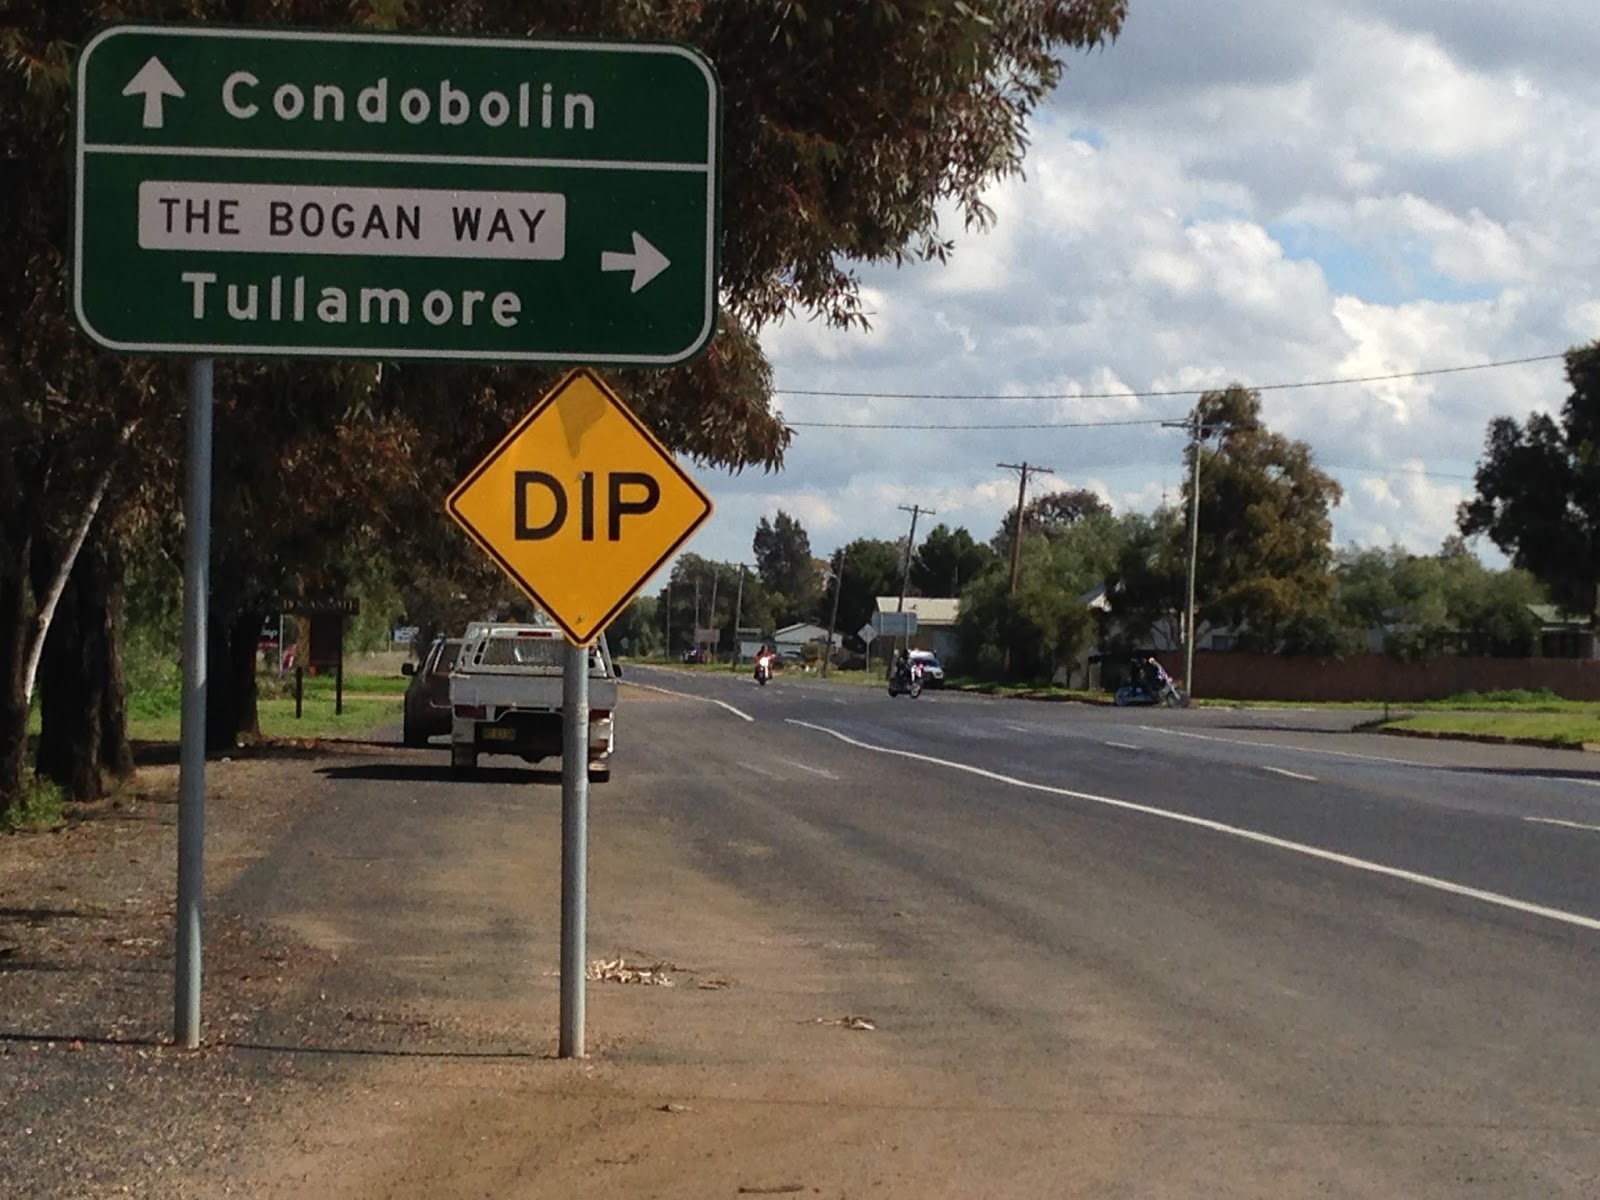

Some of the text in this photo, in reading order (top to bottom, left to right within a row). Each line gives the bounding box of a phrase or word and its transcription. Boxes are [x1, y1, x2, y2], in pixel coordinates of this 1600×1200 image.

[222, 71, 595, 130] Condobolin
[158, 197, 546, 244] THE BOGAN WAY
[181, 270, 522, 327] Tullamore
[514, 470, 661, 542] DIP
